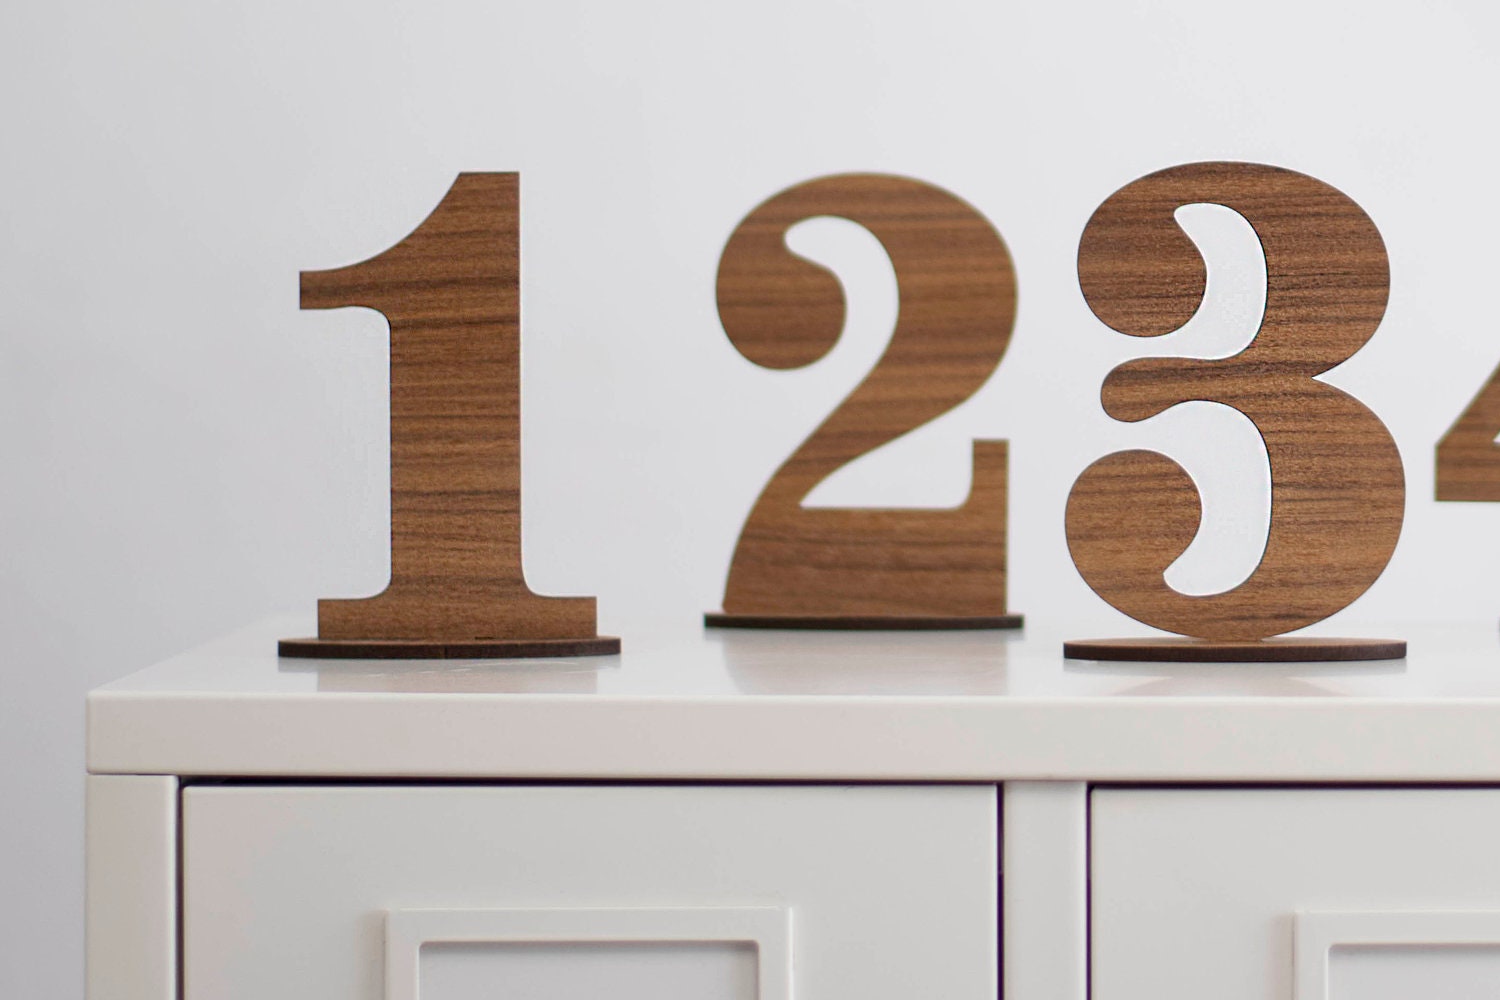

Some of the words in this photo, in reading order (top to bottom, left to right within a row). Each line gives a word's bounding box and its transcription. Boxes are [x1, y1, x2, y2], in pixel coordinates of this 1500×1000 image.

[299, 170, 598, 640] 1
[715, 171, 1019, 615] 2
[1064, 160, 1406, 641] 3
